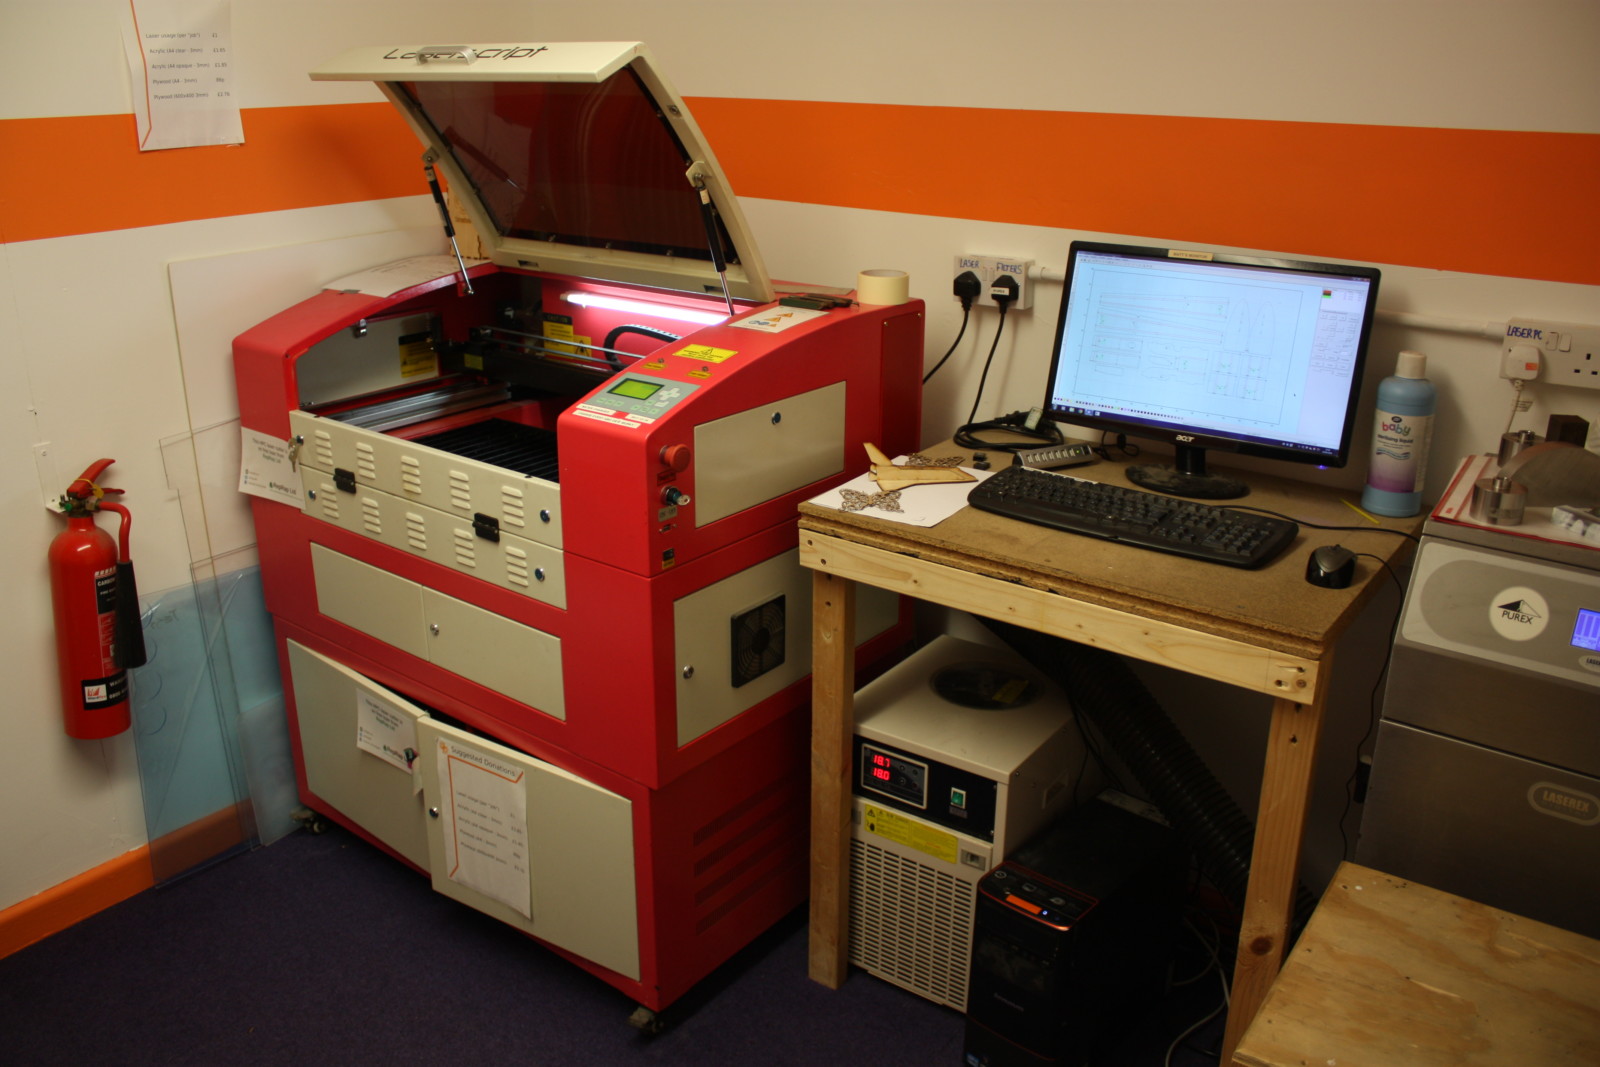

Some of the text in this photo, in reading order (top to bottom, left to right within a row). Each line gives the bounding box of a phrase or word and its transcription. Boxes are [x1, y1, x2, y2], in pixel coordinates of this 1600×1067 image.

[960, 258, 980, 269] LASER
[1506, 324, 1543, 340] LASER PC
[1382, 423, 1411, 436] baby
[1175, 434, 1195, 443] acer
[1502, 611, 1534, 625] PUREX
[451, 745, 516, 777] Suggested Donations
[1543, 791, 1590, 813] LASEREX
